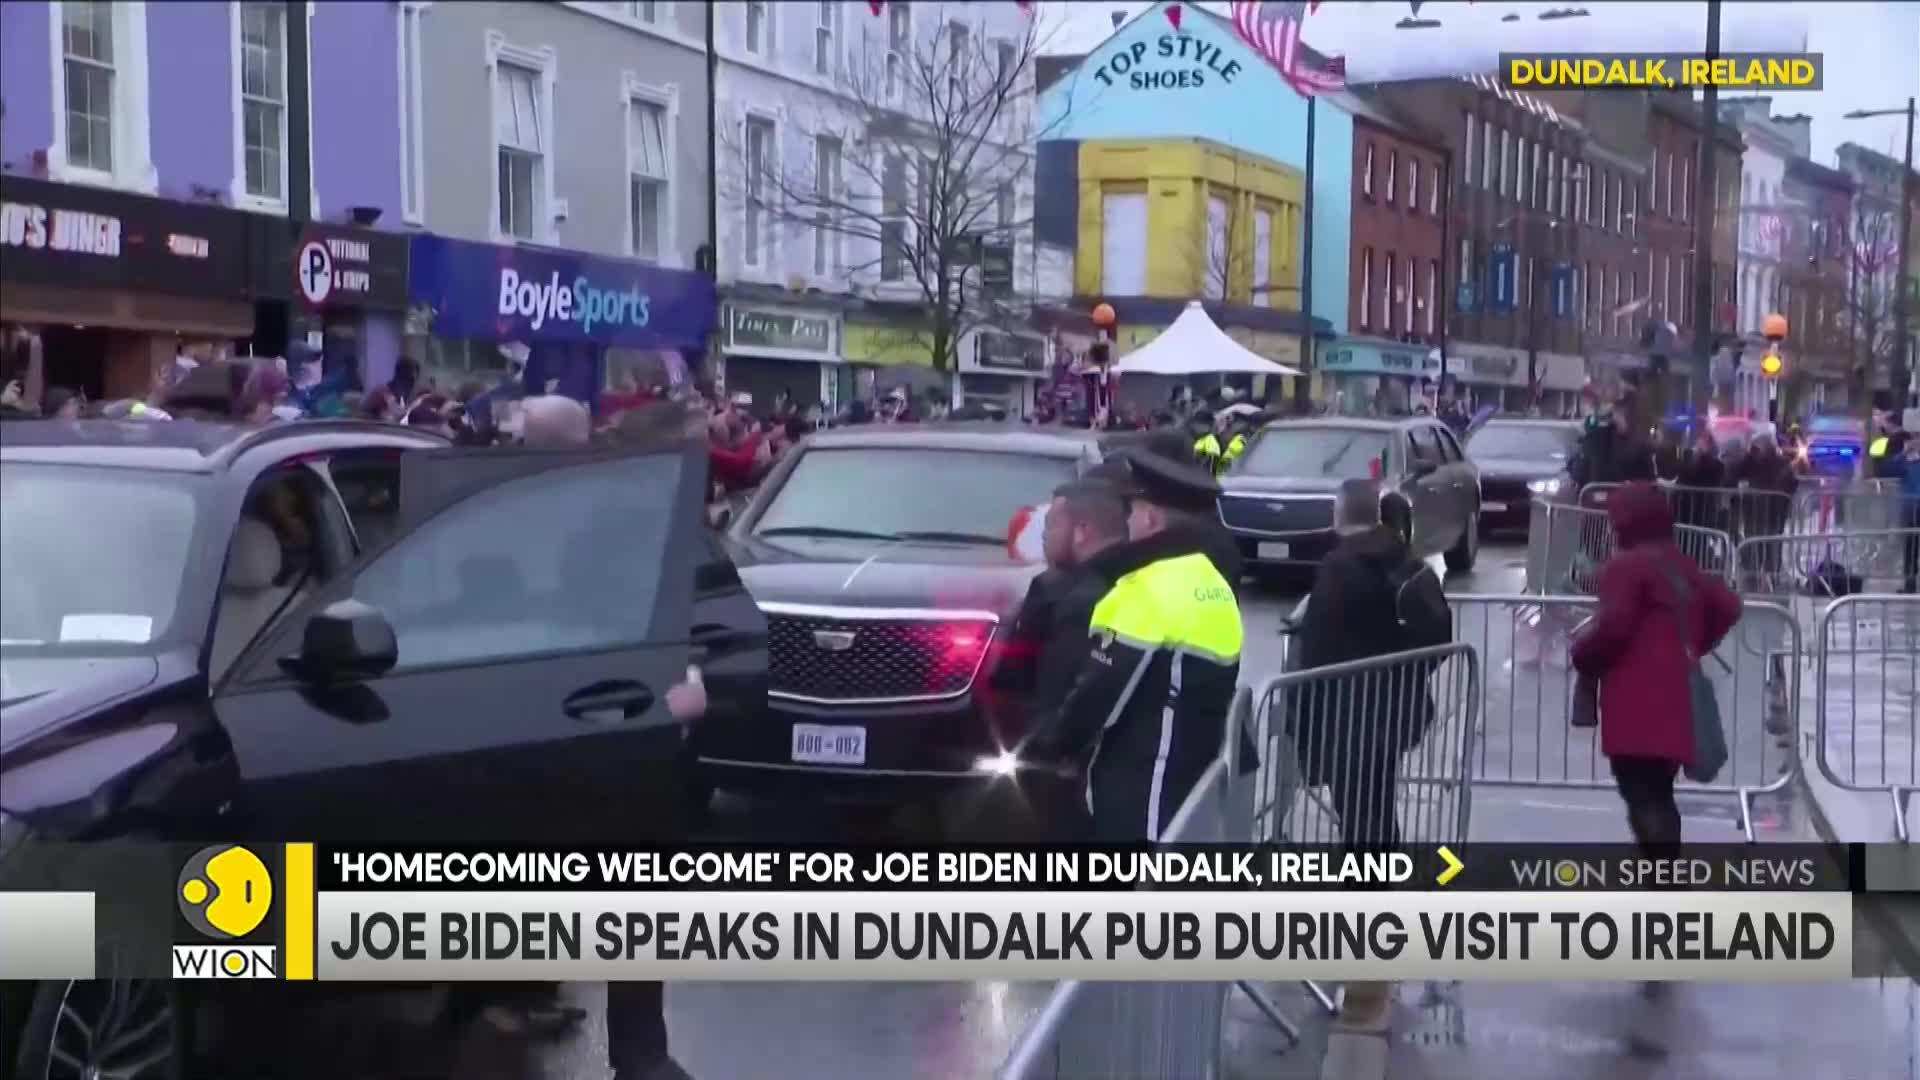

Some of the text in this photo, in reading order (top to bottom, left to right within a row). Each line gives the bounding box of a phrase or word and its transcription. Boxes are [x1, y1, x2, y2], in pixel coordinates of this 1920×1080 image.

[1094, 34, 1243, 87] TOP STYLE
[1129, 68, 1205, 90] SHOES
[49, 209, 121, 257] DINER
[499, 268, 649, 333] BoyleSports
